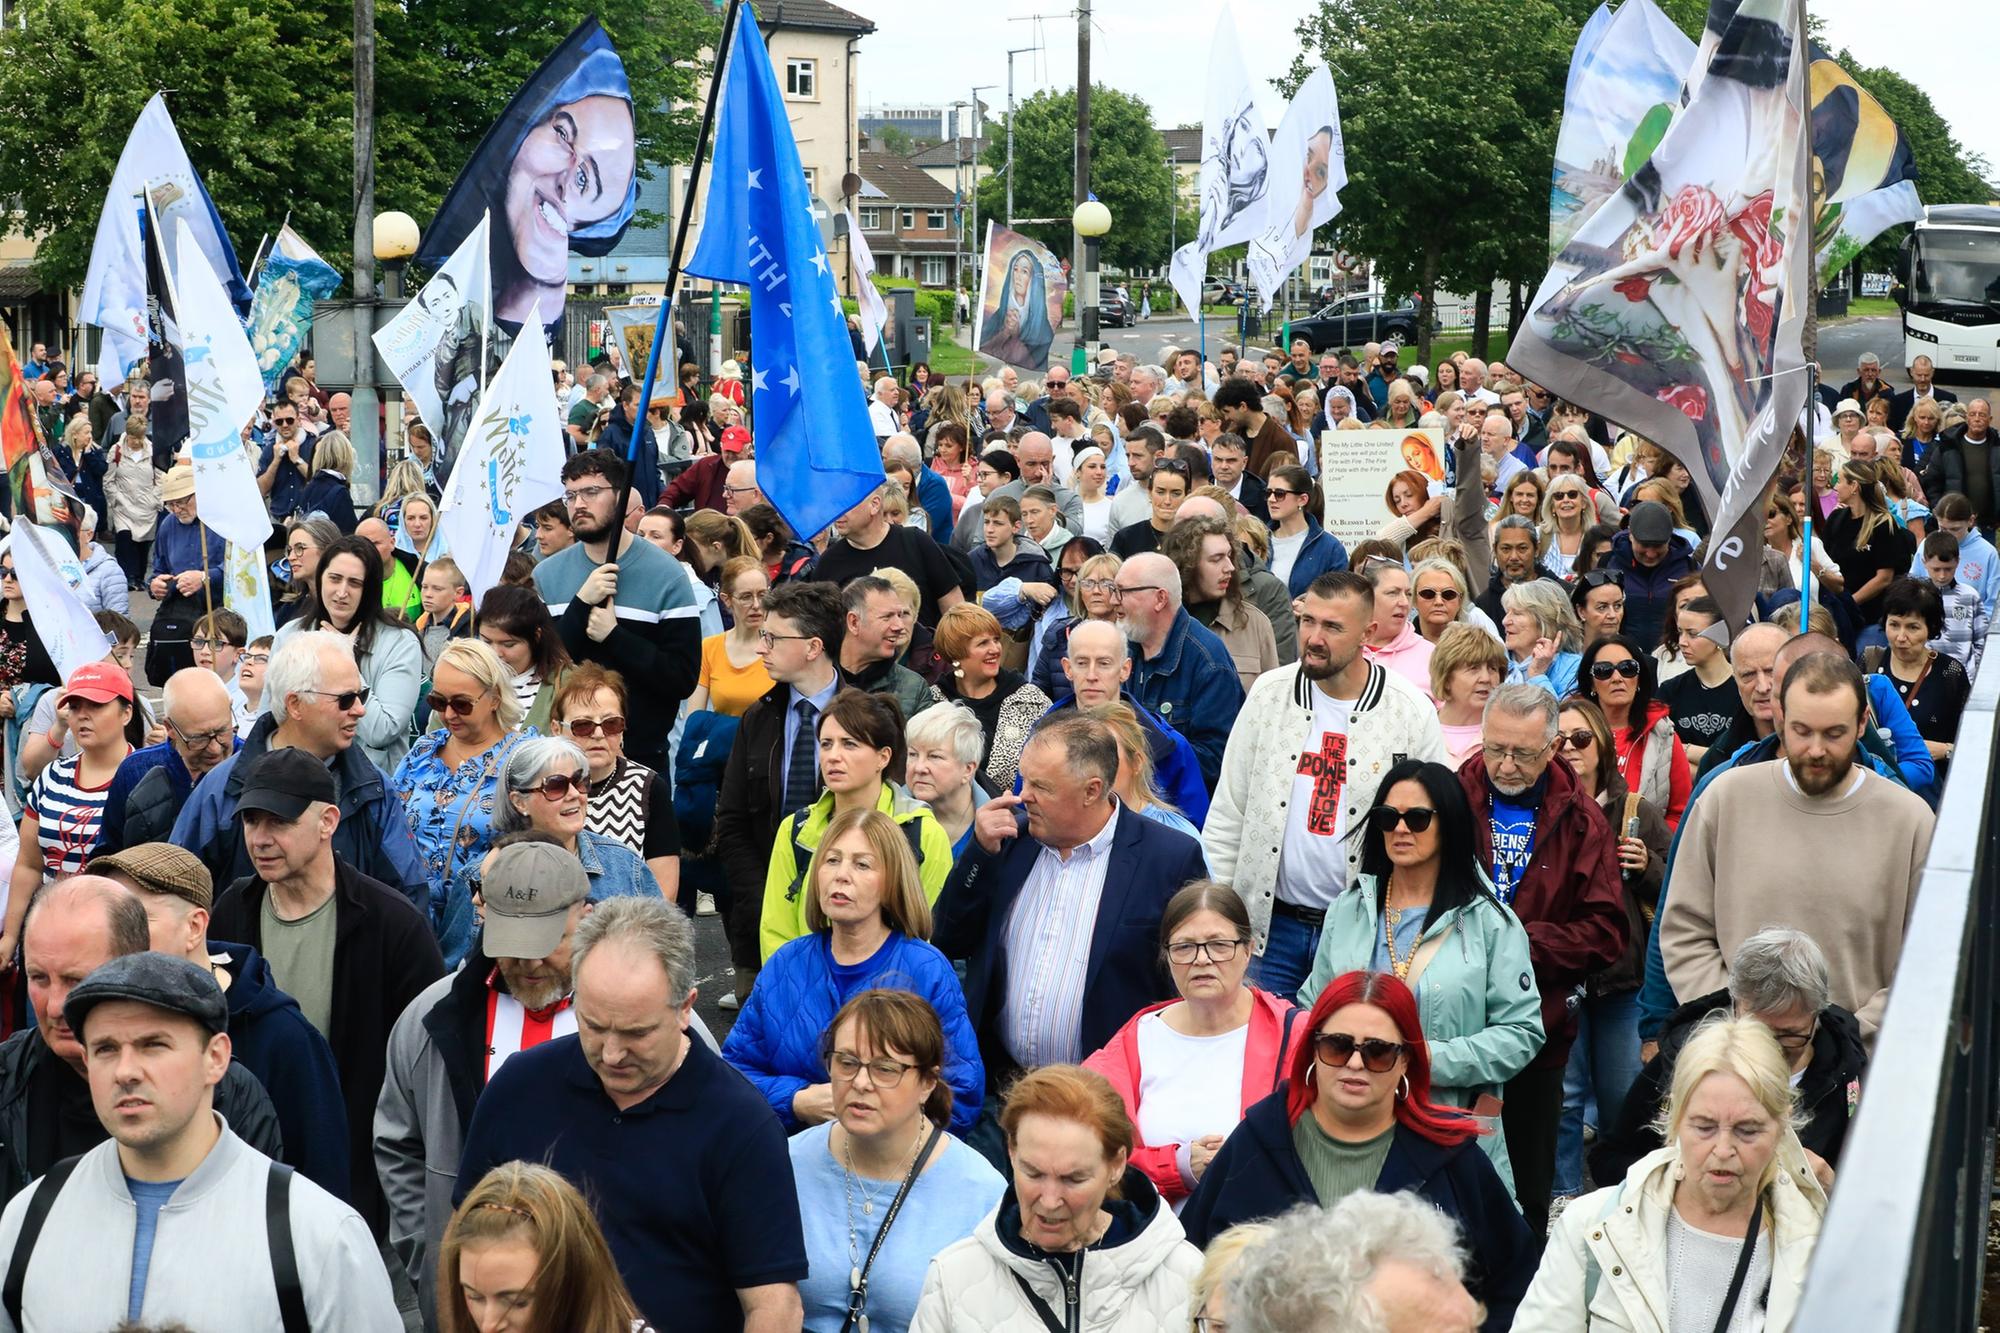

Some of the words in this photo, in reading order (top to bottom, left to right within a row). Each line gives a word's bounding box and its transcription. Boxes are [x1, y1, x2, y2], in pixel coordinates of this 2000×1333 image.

[1324, 736, 1346, 749] IT'S
[1324, 748, 1342, 760] THE
[1317, 777, 1338, 798] OF
[1313, 796, 1336, 813] LO
[1311, 812, 1333, 832] VE
[504, 886, 538, 901] A&F
